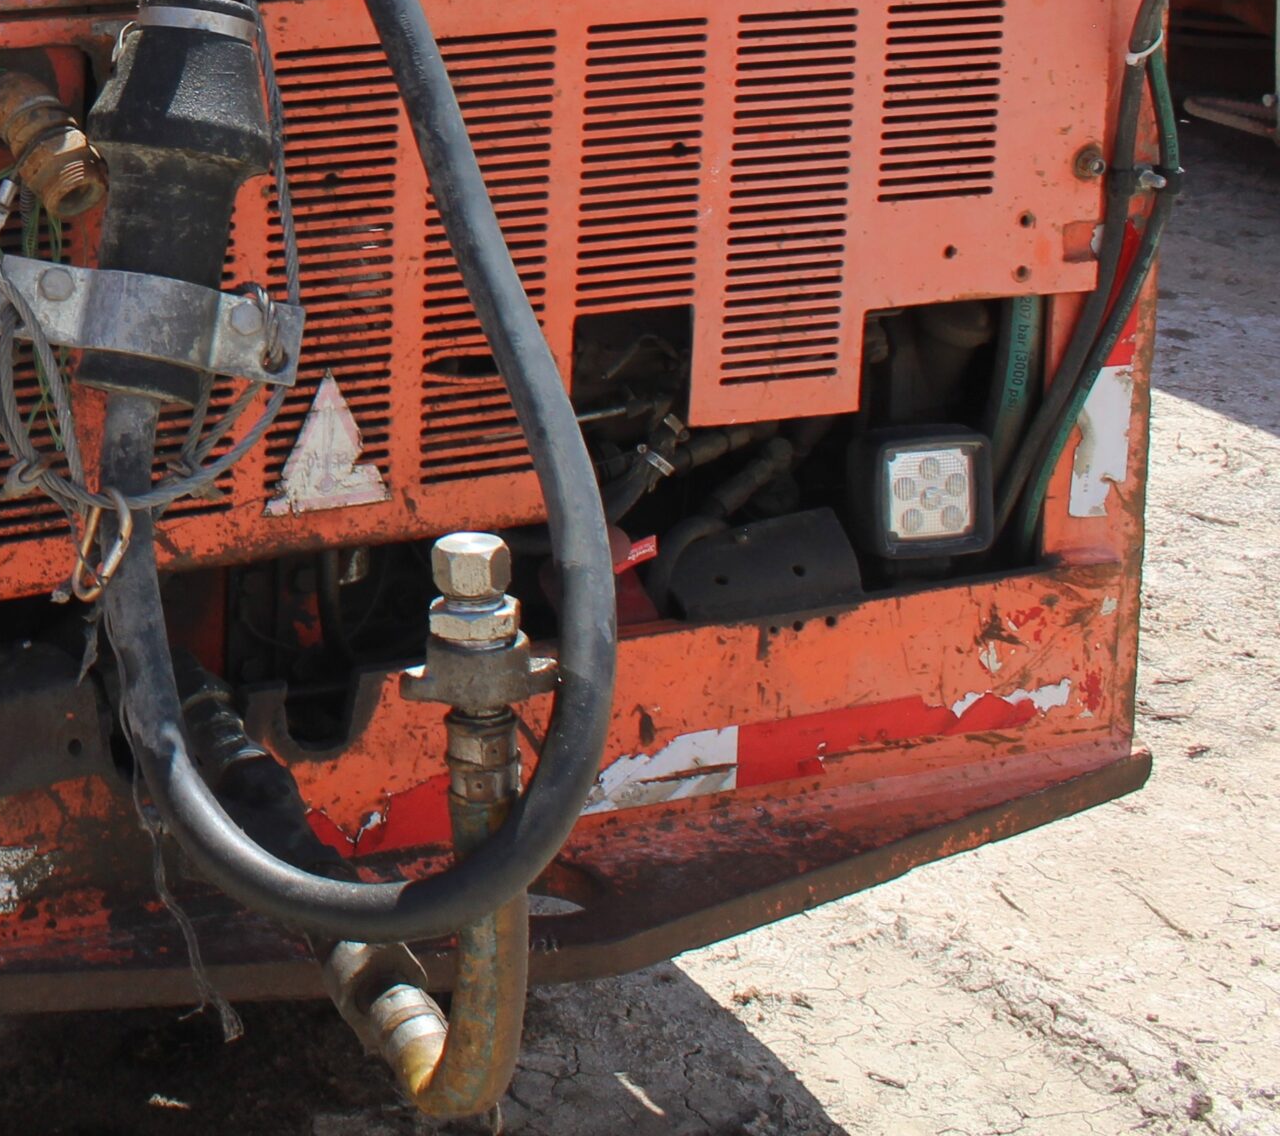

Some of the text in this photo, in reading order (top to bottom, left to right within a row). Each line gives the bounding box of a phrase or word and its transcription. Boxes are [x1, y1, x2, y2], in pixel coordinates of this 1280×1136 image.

[1019, 296, 1032, 319] 207
[1016, 325, 1030, 346] bar
[1012, 349, 1028, 386] (3000
